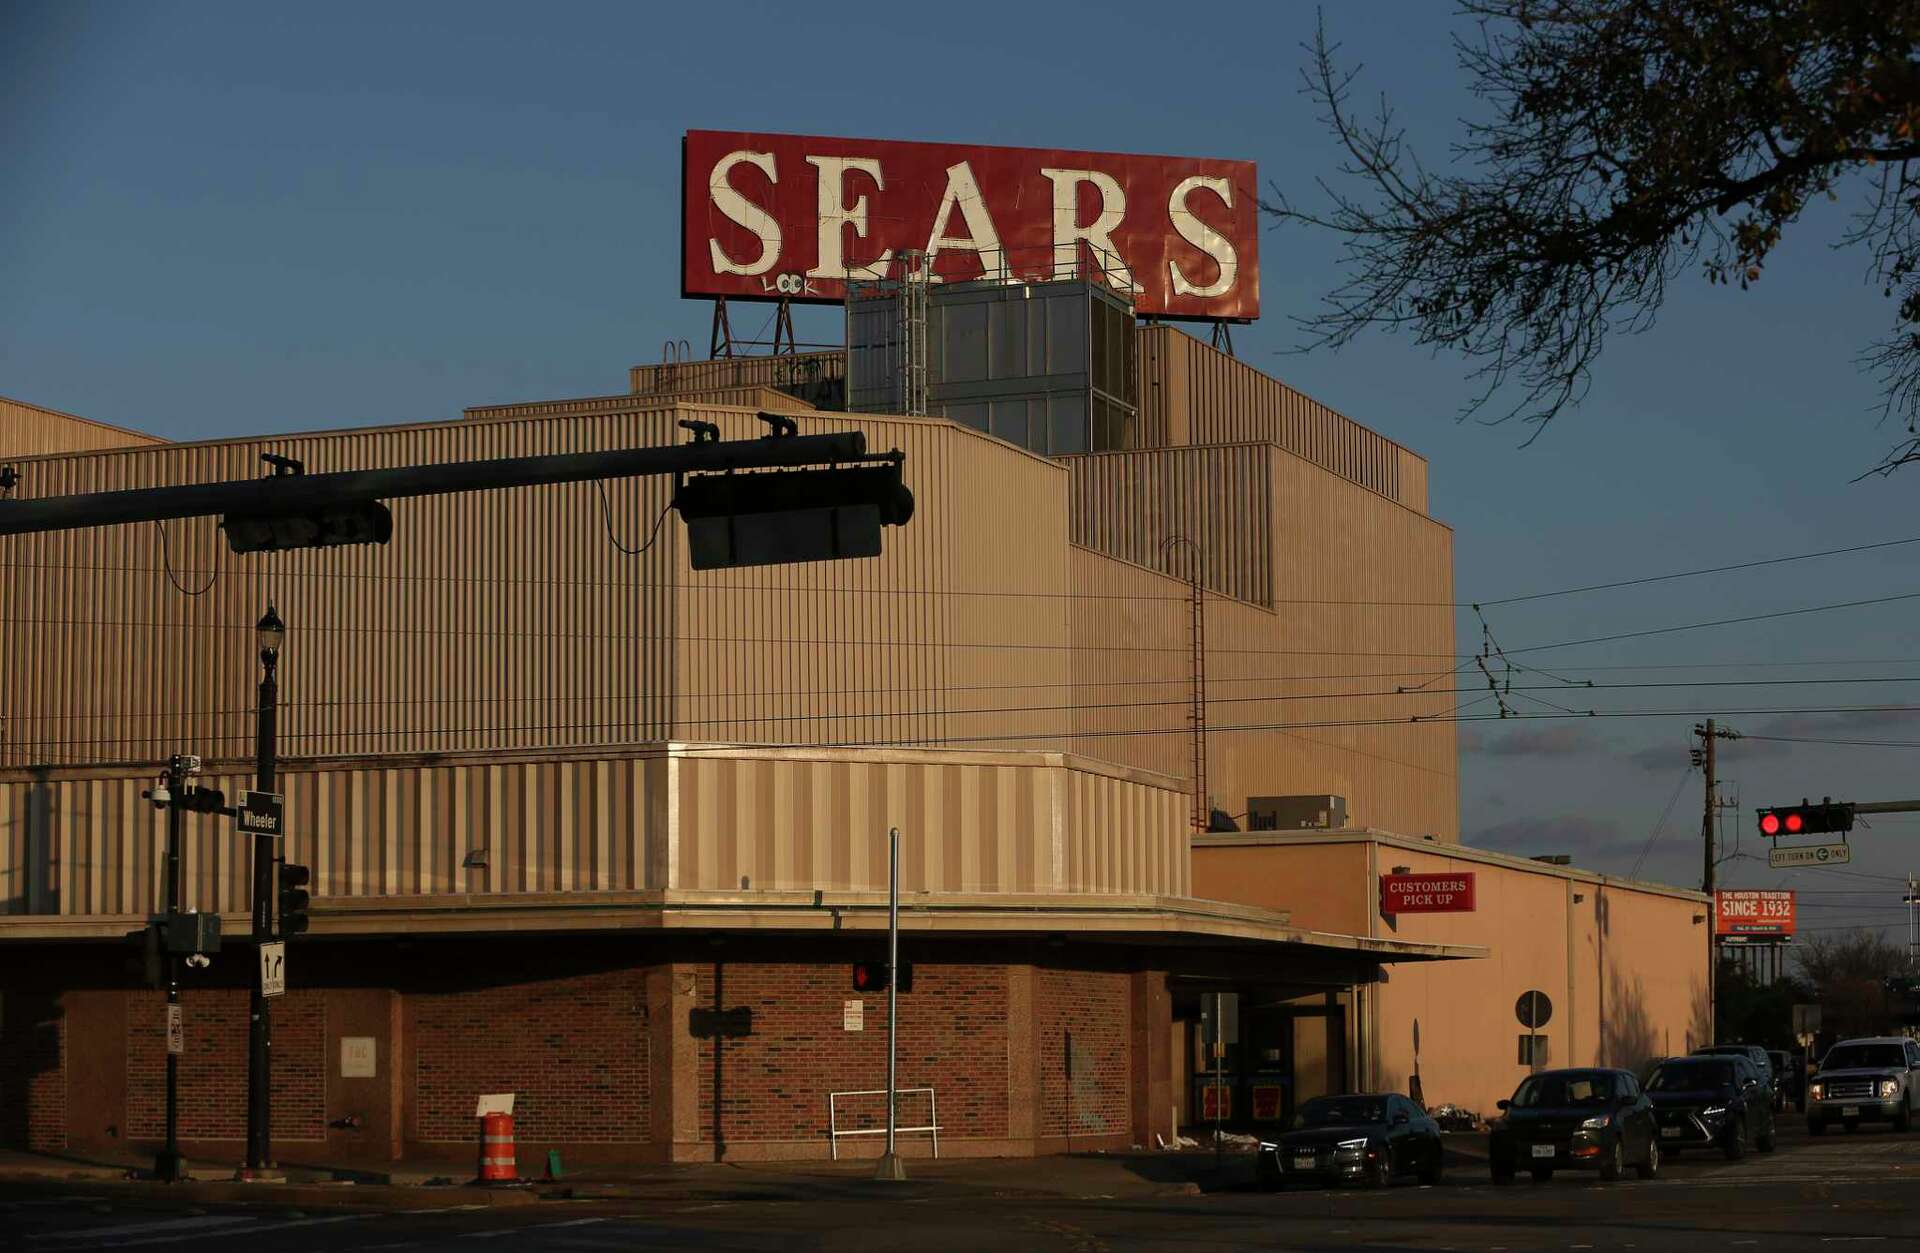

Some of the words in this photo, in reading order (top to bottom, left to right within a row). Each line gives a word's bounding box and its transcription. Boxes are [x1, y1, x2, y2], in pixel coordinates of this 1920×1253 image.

[709, 150, 1239, 298] SEARS
[761, 273, 819, 296] LOOK
[243, 809, 277, 830] Wheeler
[1831, 848, 1847, 857] ONLY
[1390, 880, 1466, 893] CUSTOMERS
[1403, 894, 1433, 905] PICK
[1436, 894, 1453, 904] UP
[1722, 891, 1732, 900] THE
[1734, 891, 1759, 900] HOUSTON
[1760, 891, 1791, 900] TRADITION
[1722, 901, 1758, 916] SINCE
[1762, 900, 1791, 916] 1932
